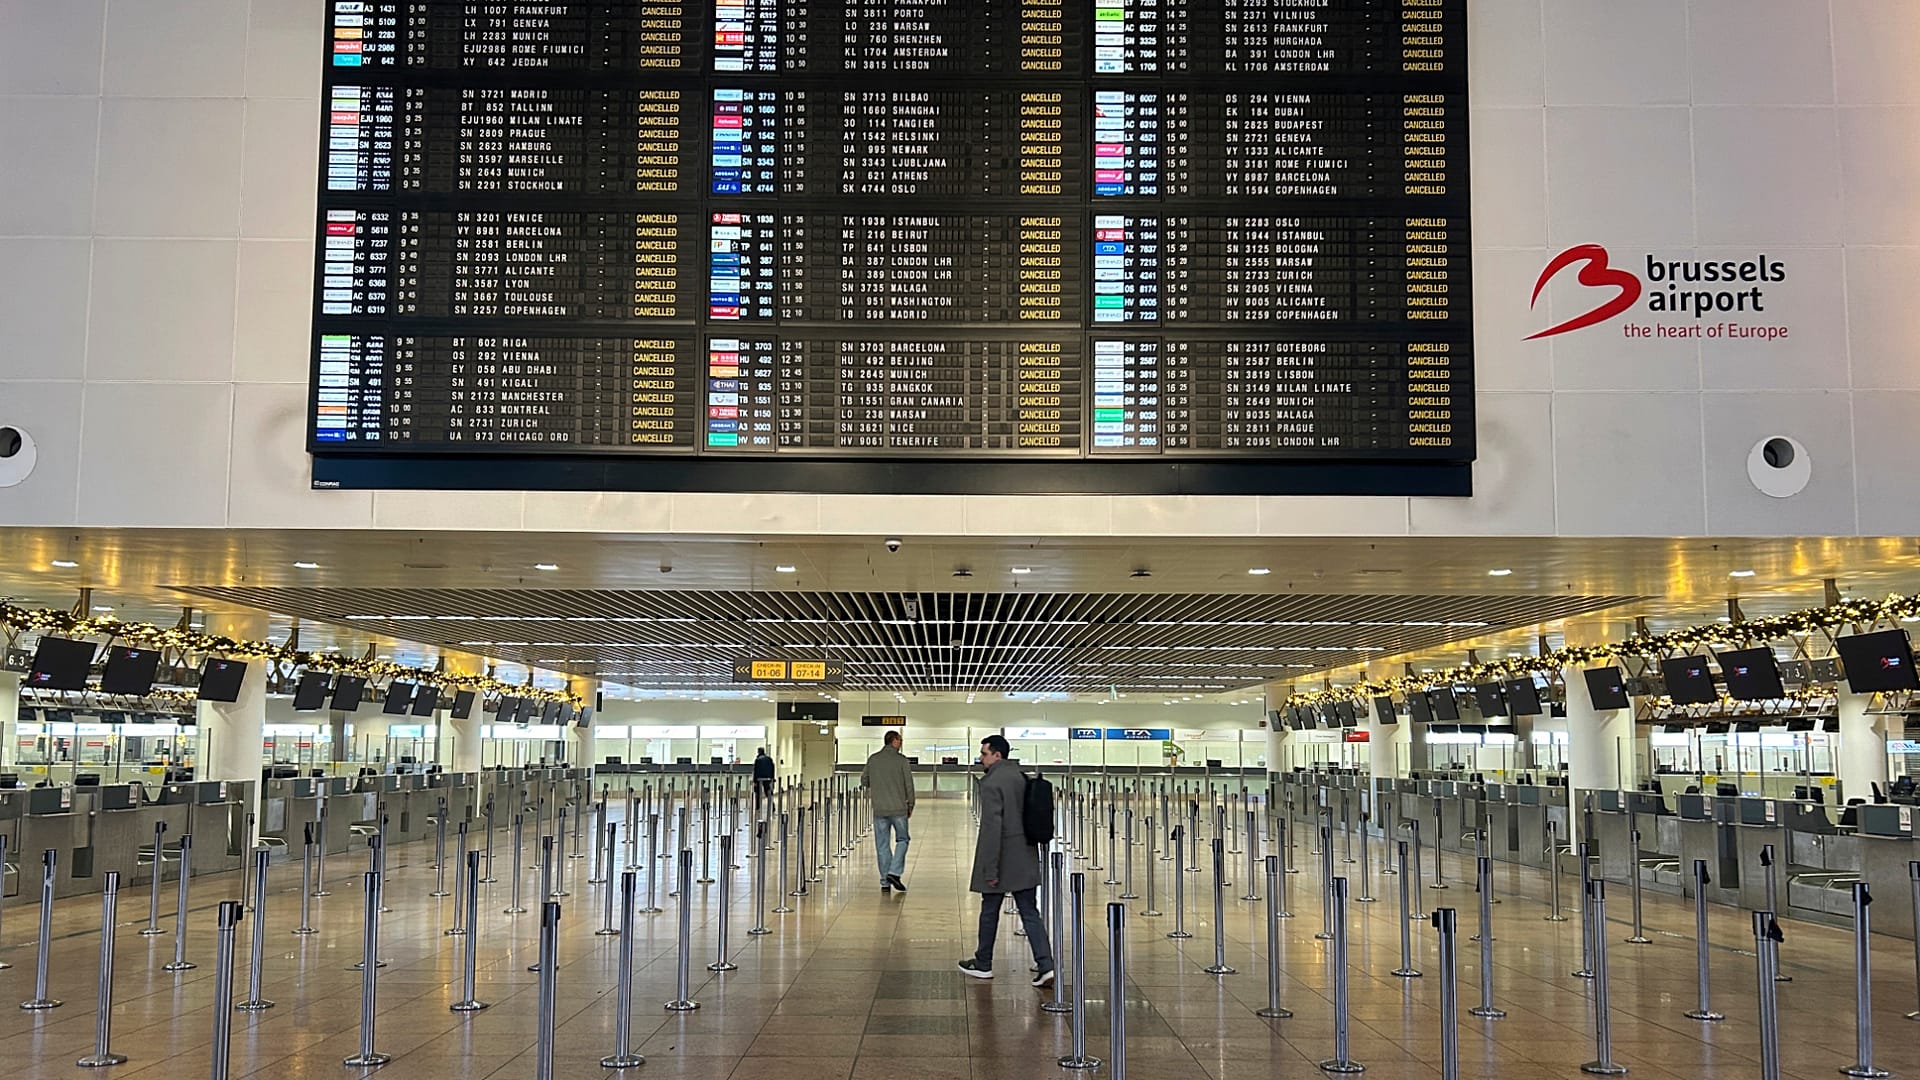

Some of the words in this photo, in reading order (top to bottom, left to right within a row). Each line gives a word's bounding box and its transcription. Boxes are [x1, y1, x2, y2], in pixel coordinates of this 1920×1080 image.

[513, 6, 567, 15] FRANKFURT
[641, 6, 682, 16] CANCELLED
[893, 8, 924, 18] PORTO
[1273, 11, 1316, 20] VILNIUS
[513, 18, 550, 28] GENEVA
[893, 22, 930, 31] WARSAW
[1273, 23, 1328, 33] FRANKFURT
[512, 32, 549, 41] MUNICH
[893, 34, 942, 44] SHENZHEN
[1021, 35, 1062, 45] CANCELLED
[1273, 36, 1322, 46] HURGHADA
[512, 44, 537, 54] ROME
[543, 45, 584, 54] FIUMICI
[893, 47, 948, 57] AMSTERDAM
[1274, 49, 1311, 59] LONDON
[1317, 49, 1335, 59] LHR
[512, 57, 549, 67] JEDDAH
[893, 60, 930, 70] LISBON
[1274, 62, 1329, 72] AMSTERDAM
[510, 89, 548, 99] MADRID
[639, 90, 680, 100] CANCELLED
[892, 92, 929, 102] BILBAO
[1274, 94, 1311, 104] VIENNA
[511, 103, 553, 112] TALLINN
[892, 105, 940, 115] SHANGHAI
[1274, 107, 1304, 117] DUBAI
[509, 116, 540, 125] MILAN
[546, 116, 583, 125] LINATE
[893, 118, 935, 128] TANGIER
[1274, 120, 1323, 130] BUDAPEST
[1403, 120, 1445, 129] CANCELLED
[509, 128, 546, 138] PRAGUE
[892, 132, 940, 141] HELSINKI
[1275, 133, 1312, 143] GENEVA
[508, 142, 552, 151] HAMBURG
[892, 145, 928, 154] NEWARK
[1274, 146, 1324, 156] ALICANTE
[508, 154, 564, 164] MARSEILLE
[892, 158, 947, 168] LJUBLJANA
[1275, 159, 1299, 169] ROME
[1306, 159, 1348, 169] FIUMICI
[508, 168, 545, 177] MUNICH
[891, 171, 929, 181] ATHENS
[1020, 171, 1062, 181] CANCELLED
[1274, 172, 1330, 182] BARCELONA
[507, 180, 563, 190] STOCKHOLM
[636, 181, 678, 191] CANCELLED
[842, 183, 855, 193] SK
[861, 184, 885, 193] 4744
[891, 184, 916, 194] OSLO
[1020, 184, 1061, 194] CANCELLED
[1275, 185, 1337, 195] COPENHAGEN
[457, 212, 470, 222] SN
[476, 213, 500, 223] 3201
[507, 213, 543, 223] VENICE
[636, 214, 678, 224] CANCELLED
[892, 216, 940, 227] ISTANBUL
[1275, 217, 1300, 228] OSLO
[506, 226, 562, 236] BARCELONA
[891, 230, 928, 240] BEIRUT
[1020, 230, 1061, 240] CANCELLED
[1277, 231, 1324, 241] ISTANBUL
[506, 239, 543, 249] BERLIN
[891, 243, 928, 253] LISBON
[1275, 244, 1319, 254] BOLOGNA
[506, 253, 543, 262] LONDON
[549, 253, 567, 263] LHR
[635, 254, 677, 263] CANCELLED
[891, 256, 928, 266] LONDON
[934, 257, 952, 267] LHR
[1275, 257, 1313, 267] WARSAW
[505, 266, 555, 276] ALICANTE
[1646, 254, 1786, 283] brussels
[891, 270, 928, 280] LONDON
[934, 270, 952, 280] LHR
[1276, 270, 1313, 280] ZURICH
[505, 279, 530, 289] LYON
[890, 283, 927, 293] MALAGA
[1276, 284, 1313, 293] VIENNA
[504, 292, 553, 302] TOULOUSE
[890, 296, 952, 306] WASHINGTON
[1276, 297, 1325, 307] ALICANTE
[1406, 297, 1449, 306] CANCELLED
[1648, 283, 1764, 318] airport
[504, 305, 566, 315] COPENHAGEN
[890, 310, 927, 320] MADRID
[1275, 310, 1338, 320] COPENHAGEN
[1623, 323, 1651, 338] the
[1656, 323, 1702, 338] heart
[1707, 323, 1724, 338] of
[1728, 323, 1788, 341] Europe
[502, 338, 528, 348] RIGA
[890, 342, 946, 353] BARCELONA
[1276, 343, 1326, 353] GOTEBORG
[1407, 343, 1450, 353] CANCELLED
[502, 351, 540, 361] VIENNA
[890, 356, 933, 366] BEIJING
[1276, 356, 1314, 366] BERLIN
[502, 365, 521, 374] ABU
[527, 365, 557, 375] DHABI
[890, 369, 927, 379] MUNICH
[1277, 370, 1314, 380] LISBON
[501, 378, 538, 388] KIGALI
[890, 383, 933, 393] BANGKOK
[1276, 383, 1308, 393] MILAN
[1314, 383, 1351, 393] LINATE
[501, 391, 564, 401] MANCHESTER
[890, 396, 915, 406] GRAN
[920, 396, 966, 406] CANARIA
[1019, 396, 1061, 406] CANCELLED
[1276, 396, 1314, 406] MUNICH
[500, 405, 550, 415] MONTREAL
[632, 406, 674, 417] CANCELLED
[841, 409, 853, 419] LO
[865, 409, 884, 419] 238
[890, 410, 927, 419] WARSAW
[1019, 409, 1061, 420] CANCELLED
[1276, 410, 1314, 419] MALAGA
[501, 418, 538, 428] ZURICH
[888, 423, 914, 433] NICE
[1277, 423, 1314, 433] PRAGUE
[1409, 423, 1452, 433] CANCELLED
[449, 431, 462, 441] UA
[475, 431, 493, 441] 973
[500, 431, 544, 441] CHICAGO
[550, 432, 569, 442] ORD
[631, 433, 674, 443] CANCELLED
[888, 436, 939, 446] TENERIFE
[1277, 436, 1315, 446] LONDON
[1321, 437, 1340, 446] LHR
[756, 669, 781, 677] 01-06
[796, 669, 820, 678] 07-14
